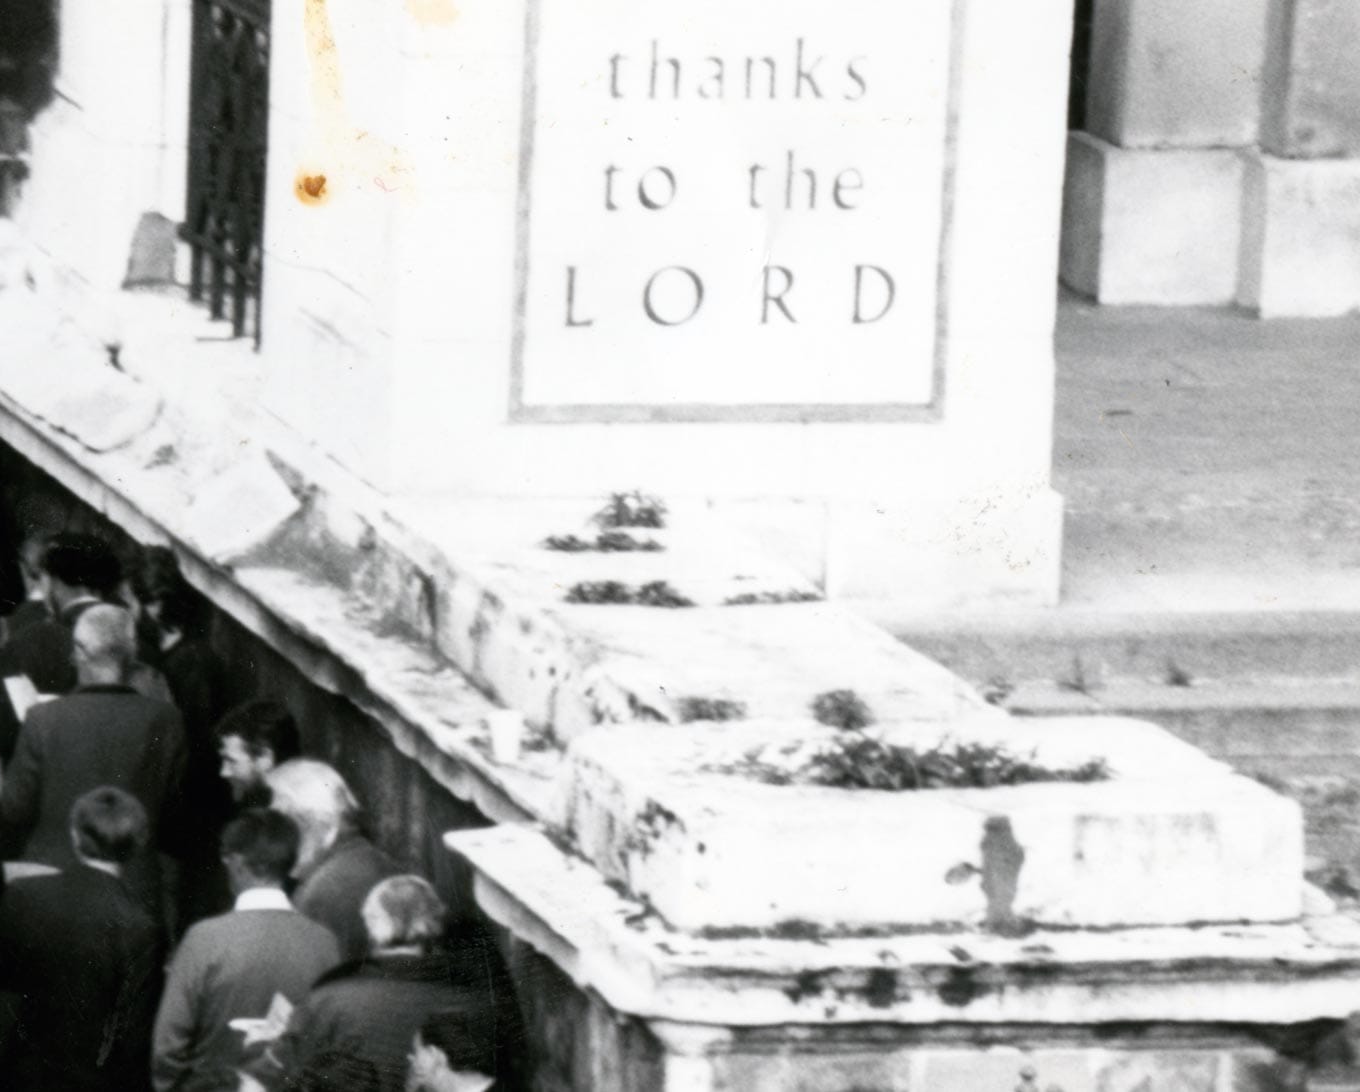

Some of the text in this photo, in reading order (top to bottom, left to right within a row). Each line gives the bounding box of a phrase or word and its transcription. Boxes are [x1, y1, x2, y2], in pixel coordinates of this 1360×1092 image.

[609, 38, 867, 100] thanks
[604, 150, 864, 211] to the
[565, 264, 896, 327] LORD
